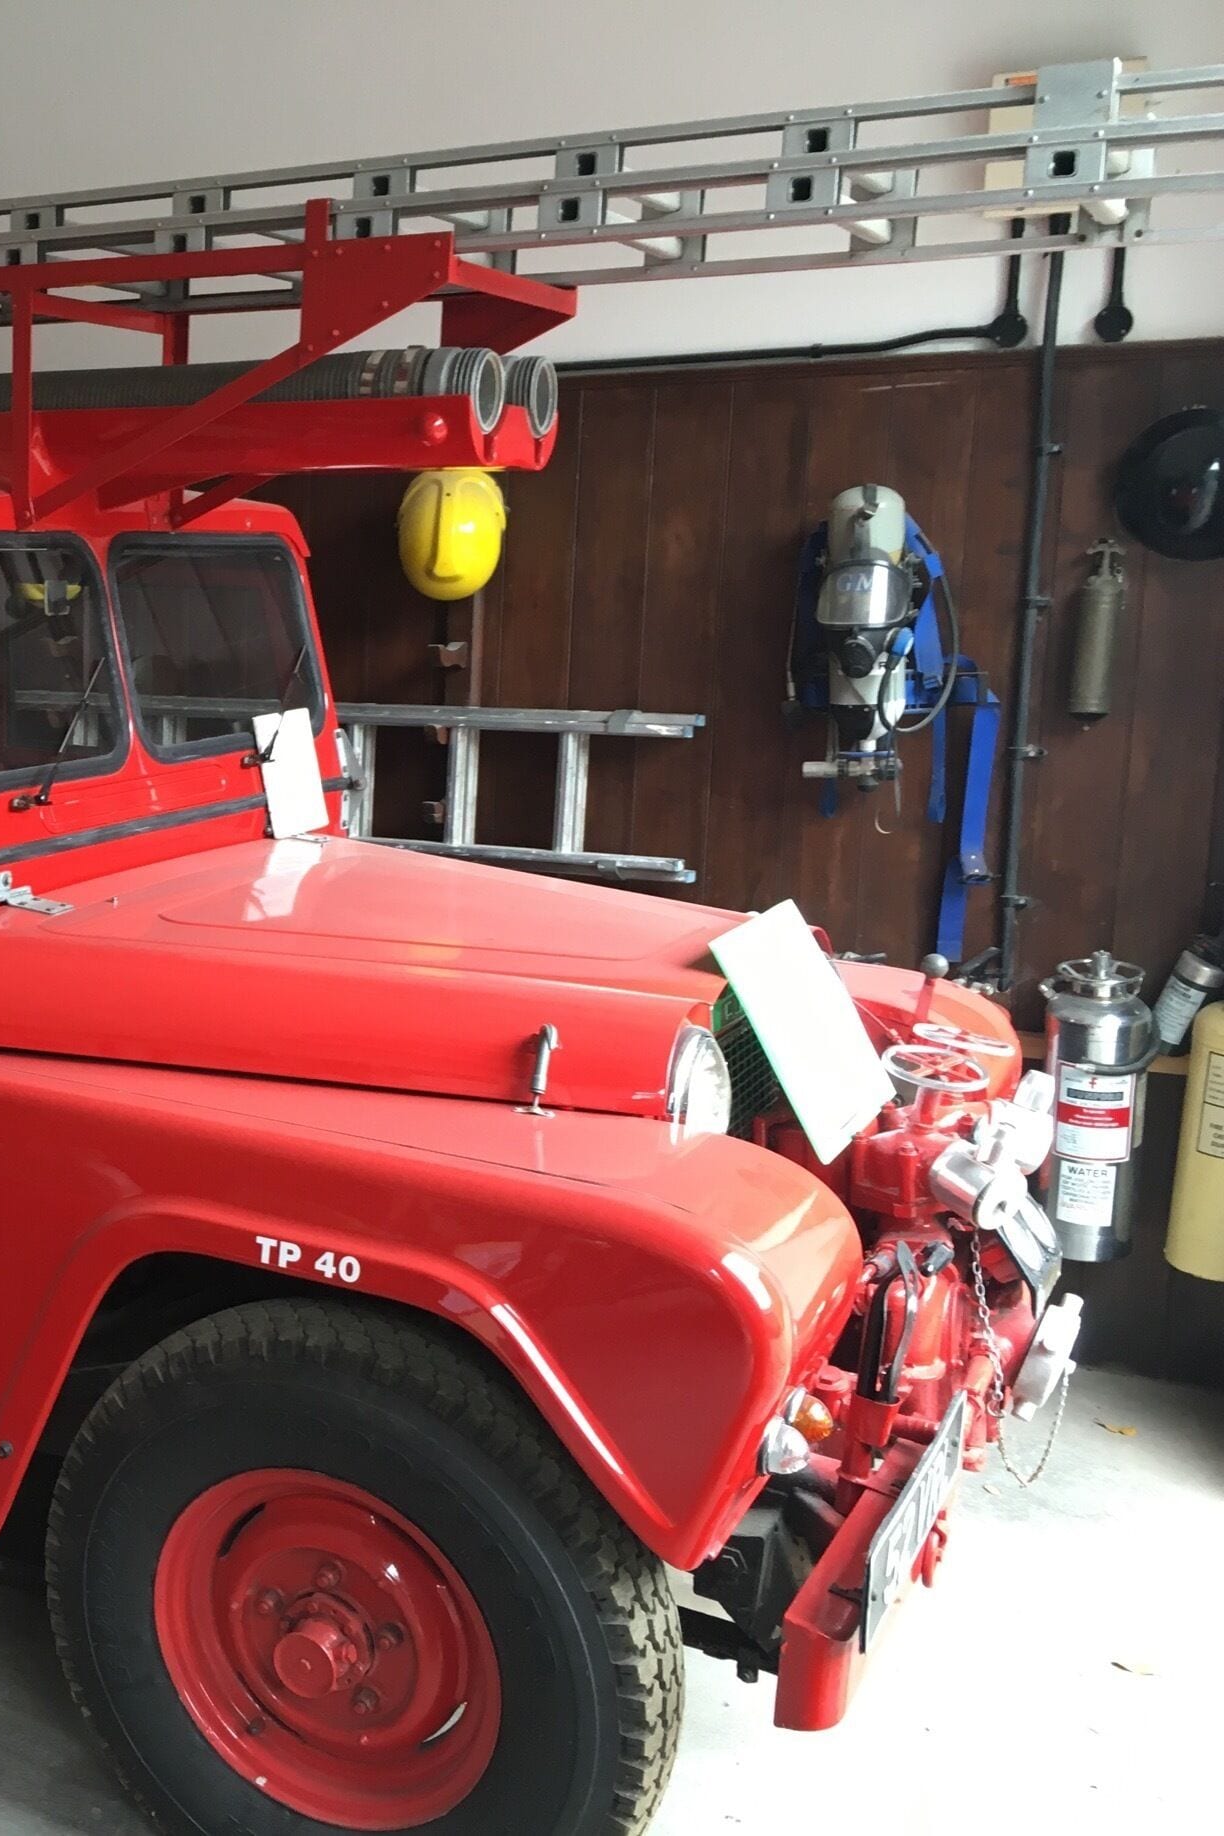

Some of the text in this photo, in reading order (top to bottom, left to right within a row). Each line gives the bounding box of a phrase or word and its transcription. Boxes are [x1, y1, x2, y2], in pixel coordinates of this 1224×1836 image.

[1067, 1166, 1108, 1177] WATER
[255, 1235, 361, 1283] TP 40
